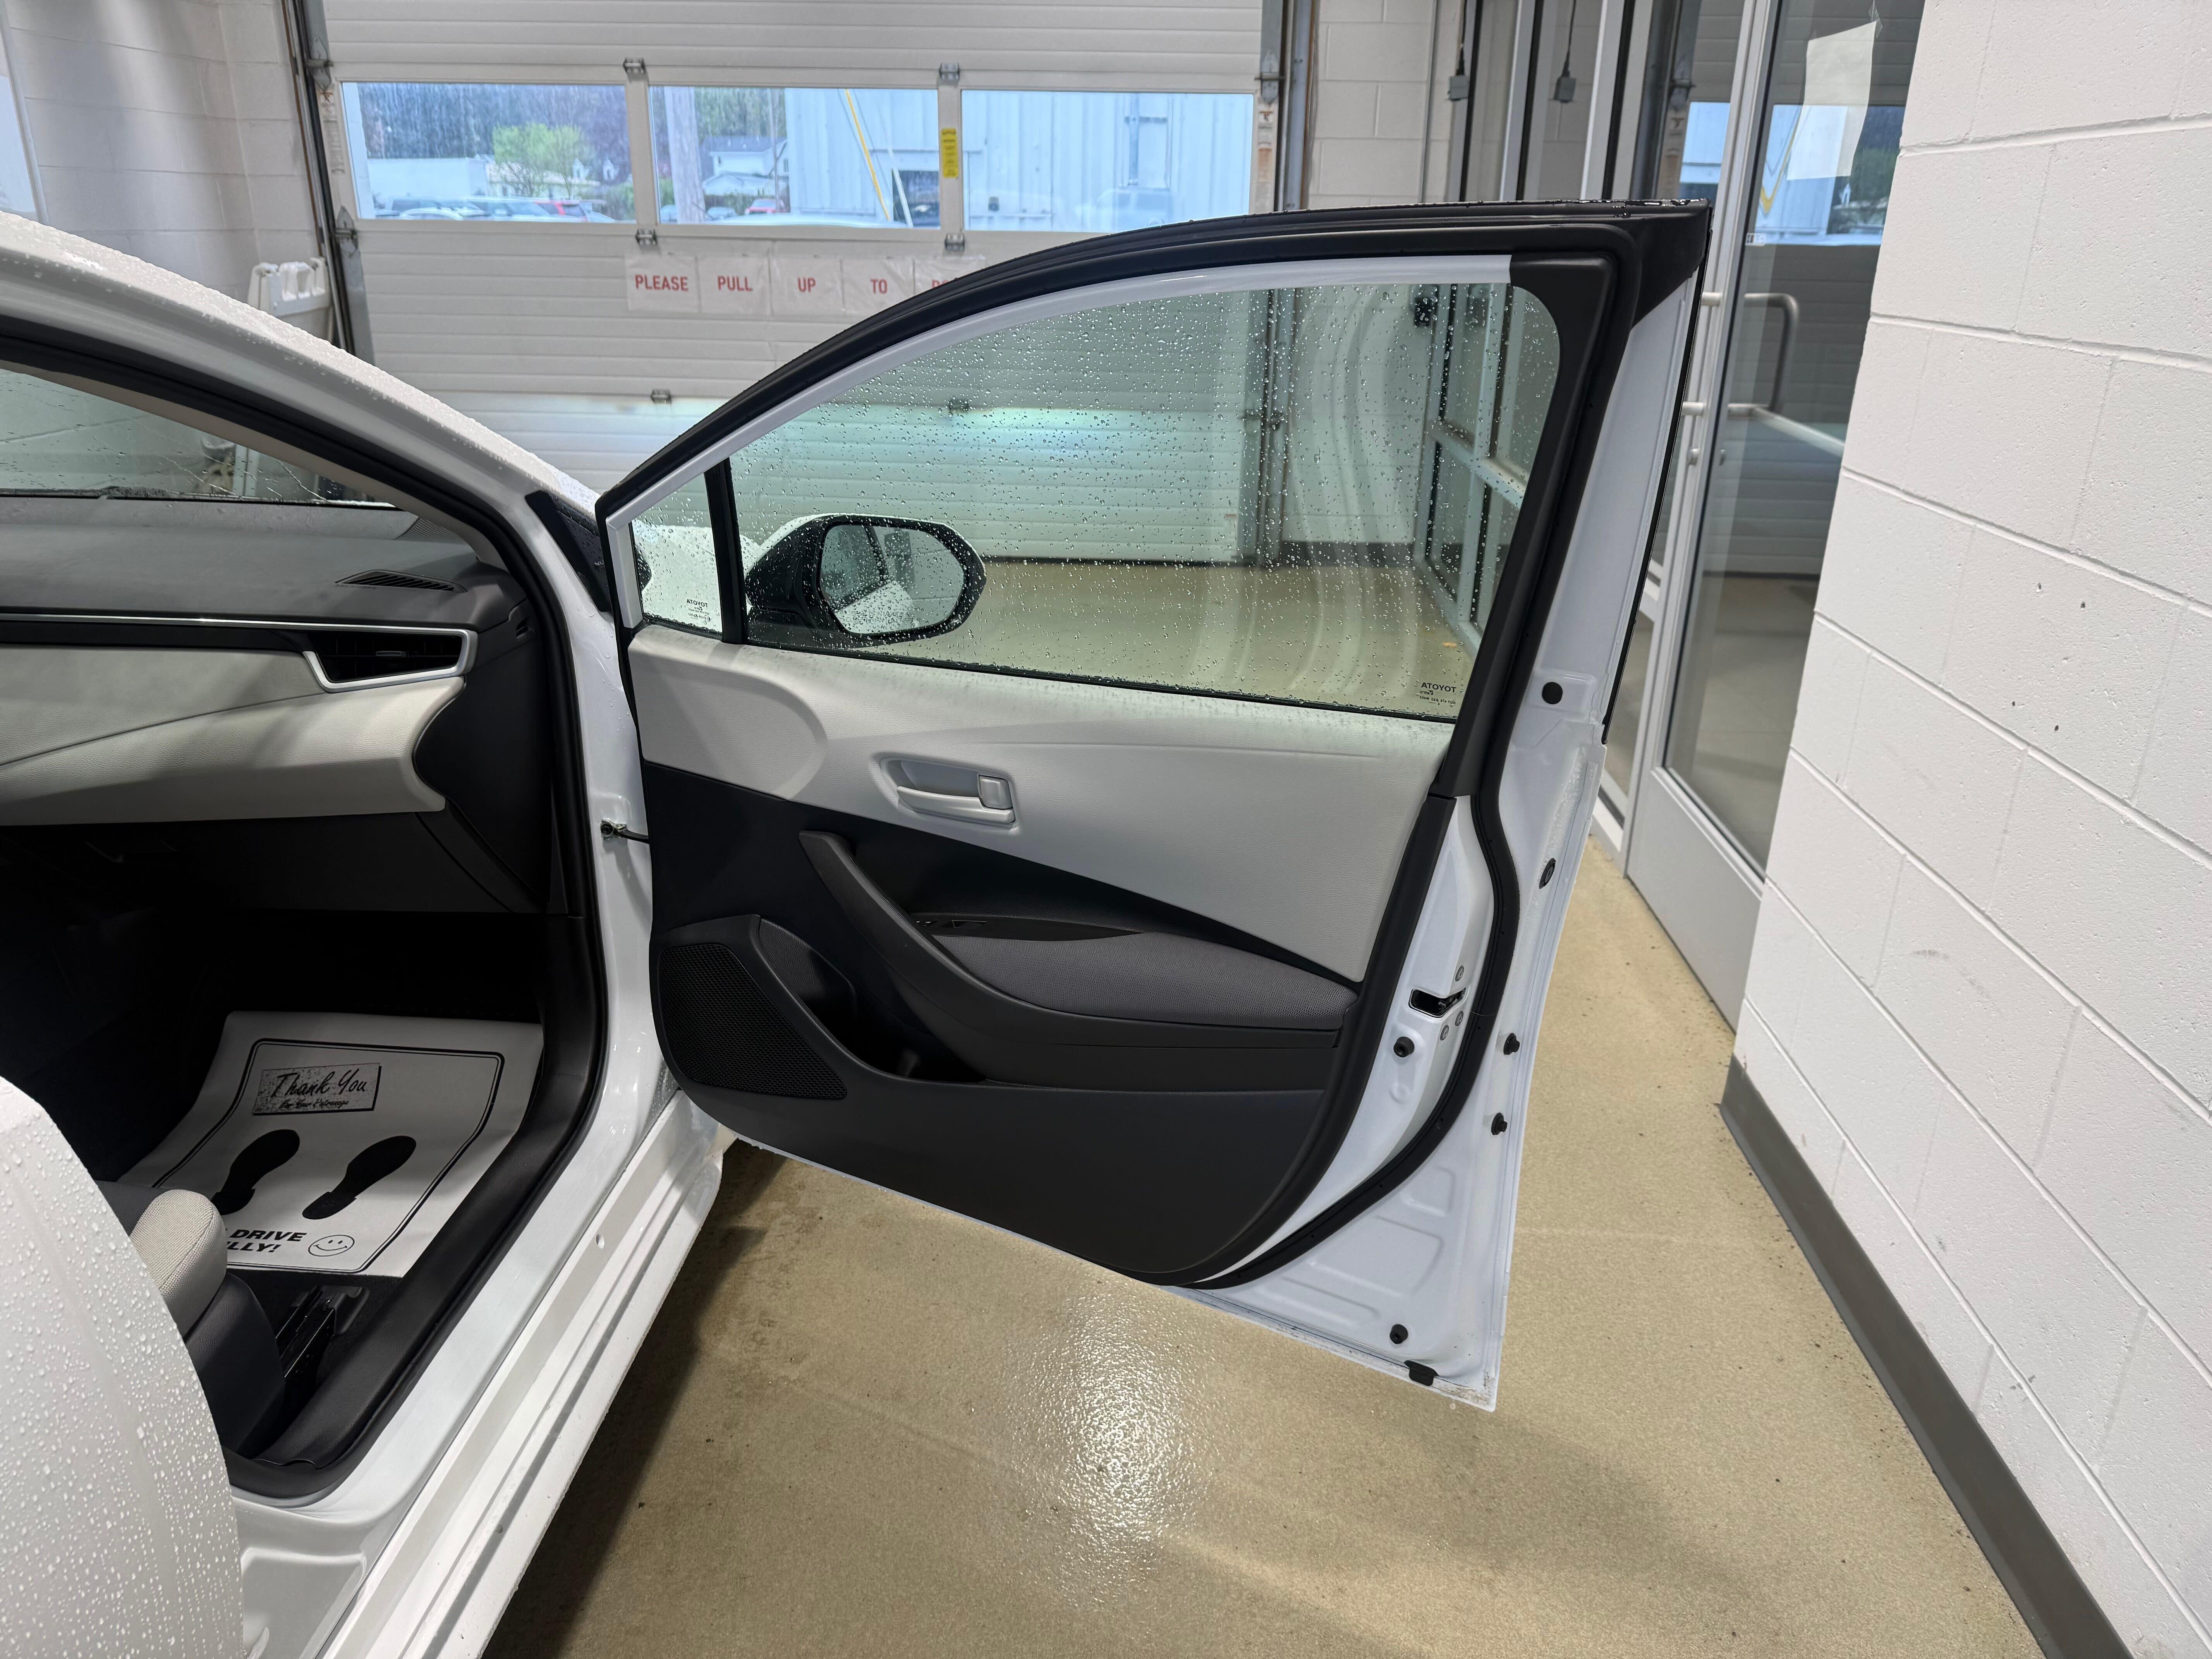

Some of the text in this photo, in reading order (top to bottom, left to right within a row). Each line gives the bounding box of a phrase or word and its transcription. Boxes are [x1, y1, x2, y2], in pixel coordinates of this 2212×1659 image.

[635, 274, 888, 294] PLEASE PULL UP TO
[271, 1068, 367, 1098] Thank You
[229, 1229, 307, 1242] DRIVE
[227, 1242, 282, 1252] LLY!
